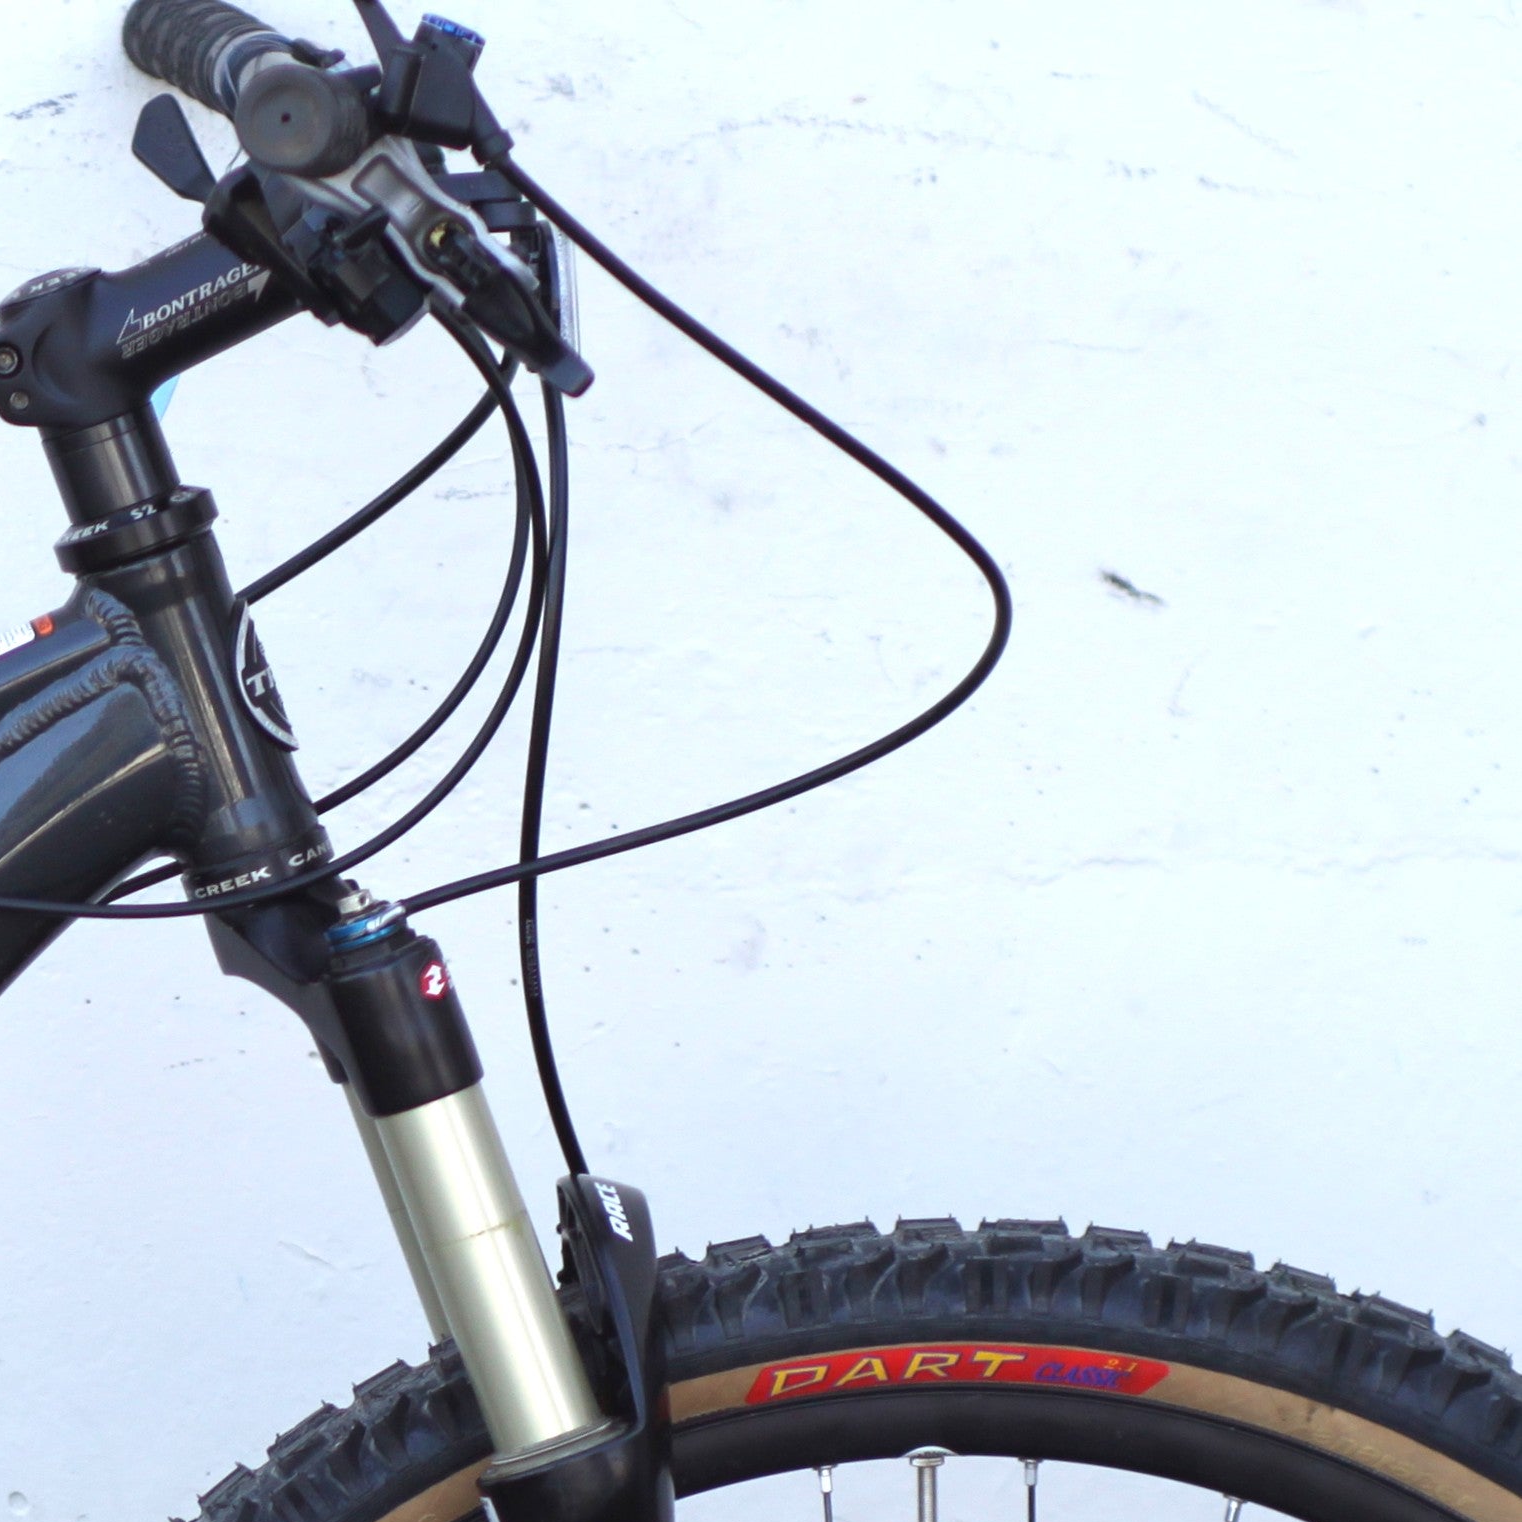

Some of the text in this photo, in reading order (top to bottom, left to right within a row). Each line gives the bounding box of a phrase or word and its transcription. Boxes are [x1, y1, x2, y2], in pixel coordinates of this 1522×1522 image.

[142, 263, 261, 330] BONTRAGE
[194, 841, 331, 898] CREEK CAN
[768, 1350, 1028, 1398] DART
